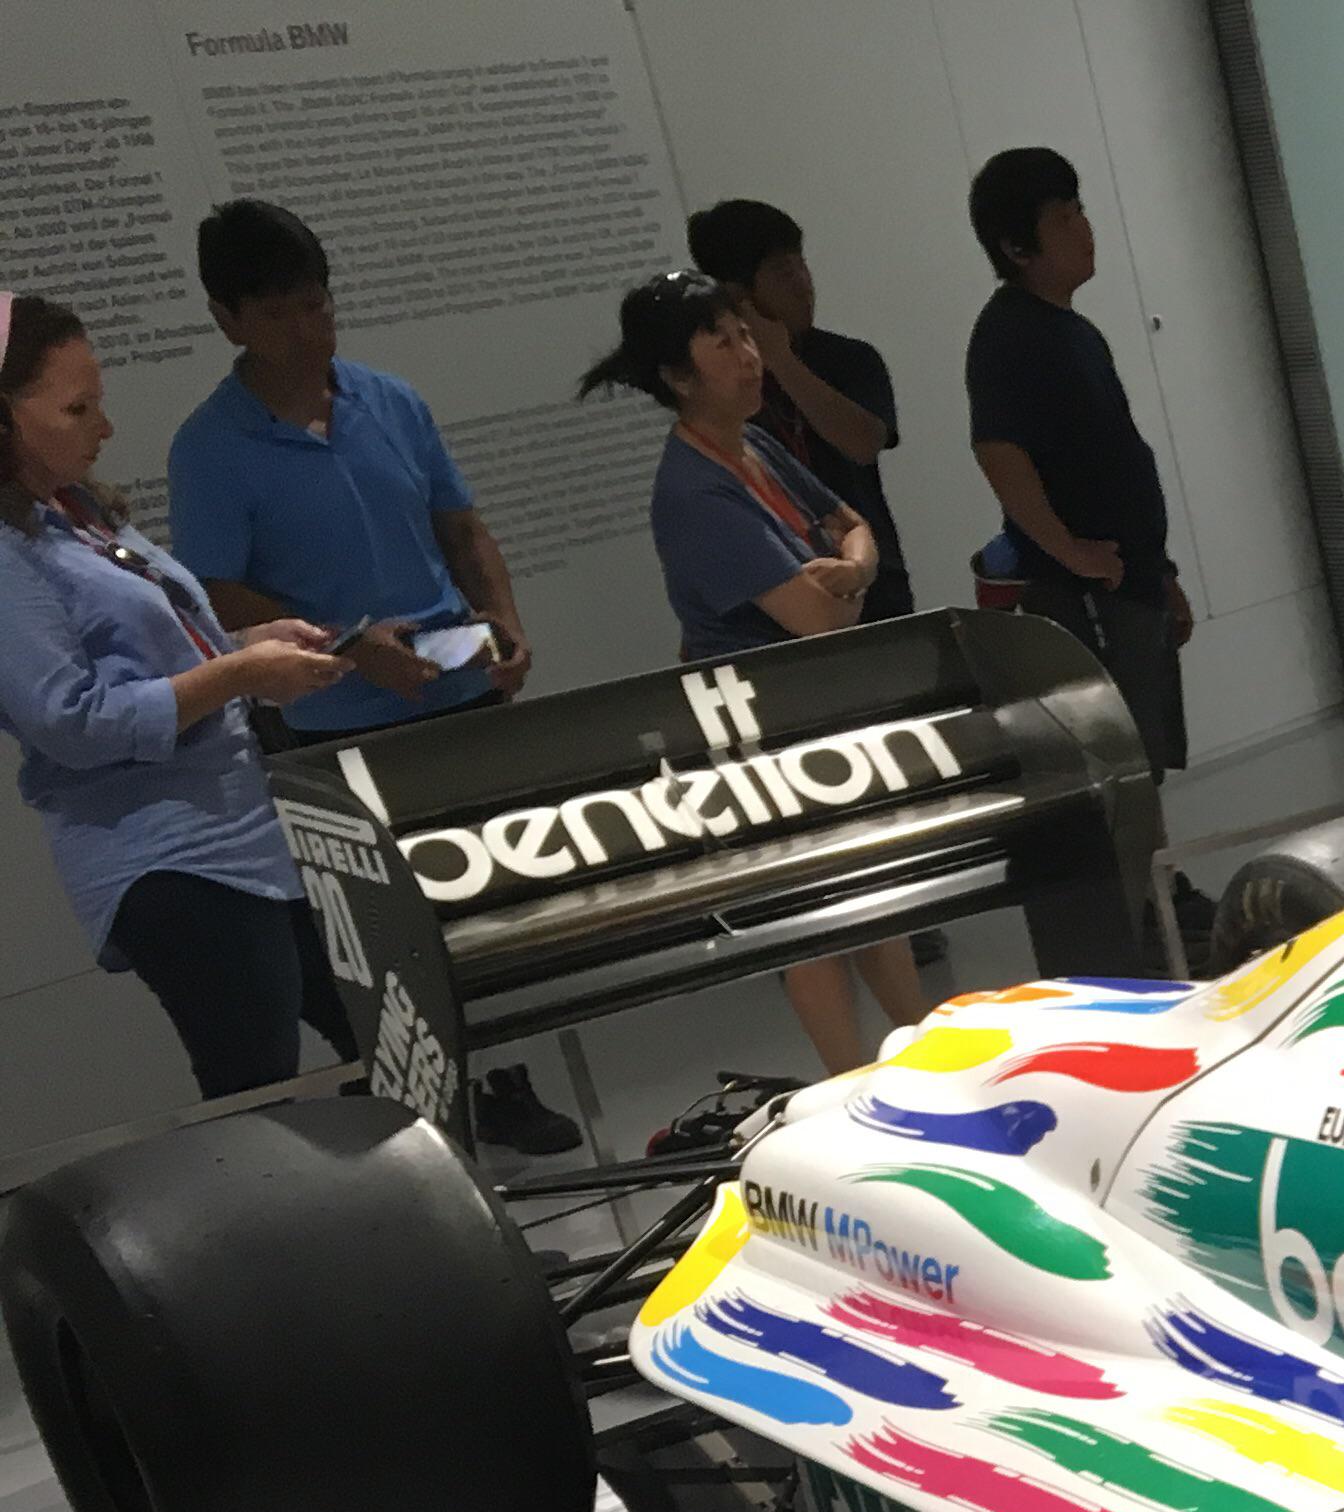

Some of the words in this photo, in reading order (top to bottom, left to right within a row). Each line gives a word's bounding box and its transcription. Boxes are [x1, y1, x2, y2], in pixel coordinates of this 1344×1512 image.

[185, 27, 286, 56] Formula
[287, 22, 348, 49] BMW
[337, 664, 962, 901] benetton
[273, 797, 390, 881] PIRELLI
[745, 1180, 818, 1252] BMW
